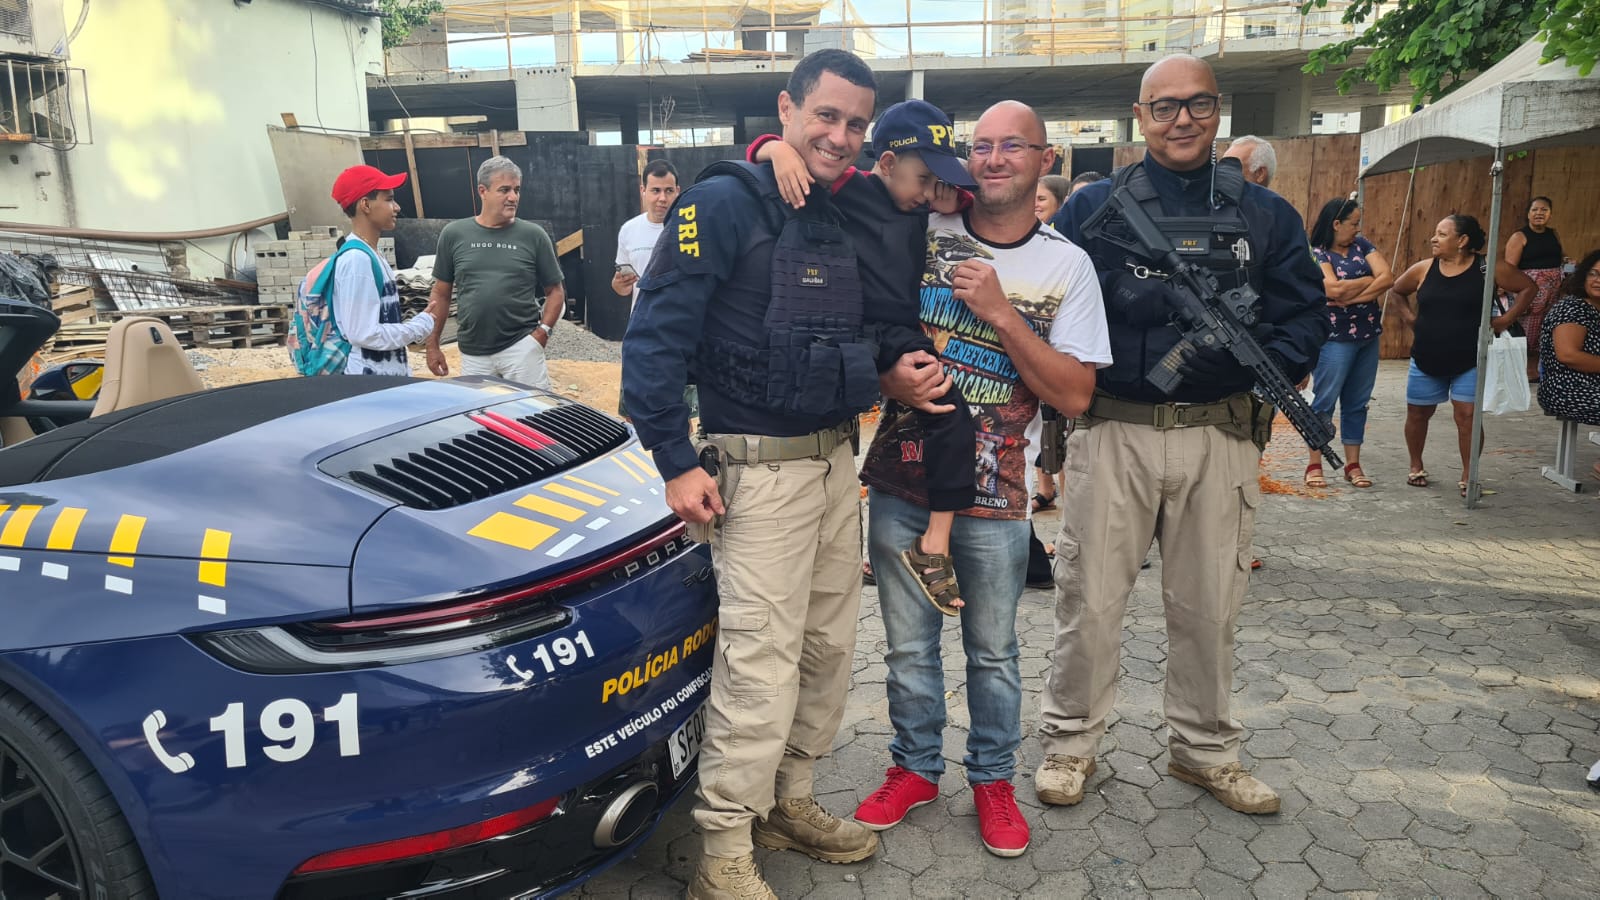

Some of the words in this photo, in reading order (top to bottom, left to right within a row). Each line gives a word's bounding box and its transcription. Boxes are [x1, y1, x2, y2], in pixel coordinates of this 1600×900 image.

[678, 204, 700, 257] PRF
[974, 495, 1008, 508] BRENO
[625, 532, 691, 577] PORS
[533, 630, 595, 673] 191
[602, 646, 679, 703] POLÍCIA
[209, 693, 360, 768] 191
[585, 733, 619, 758] ESTE
[617, 707, 662, 740] VEÍCULO
[660, 697, 679, 713] FOI
